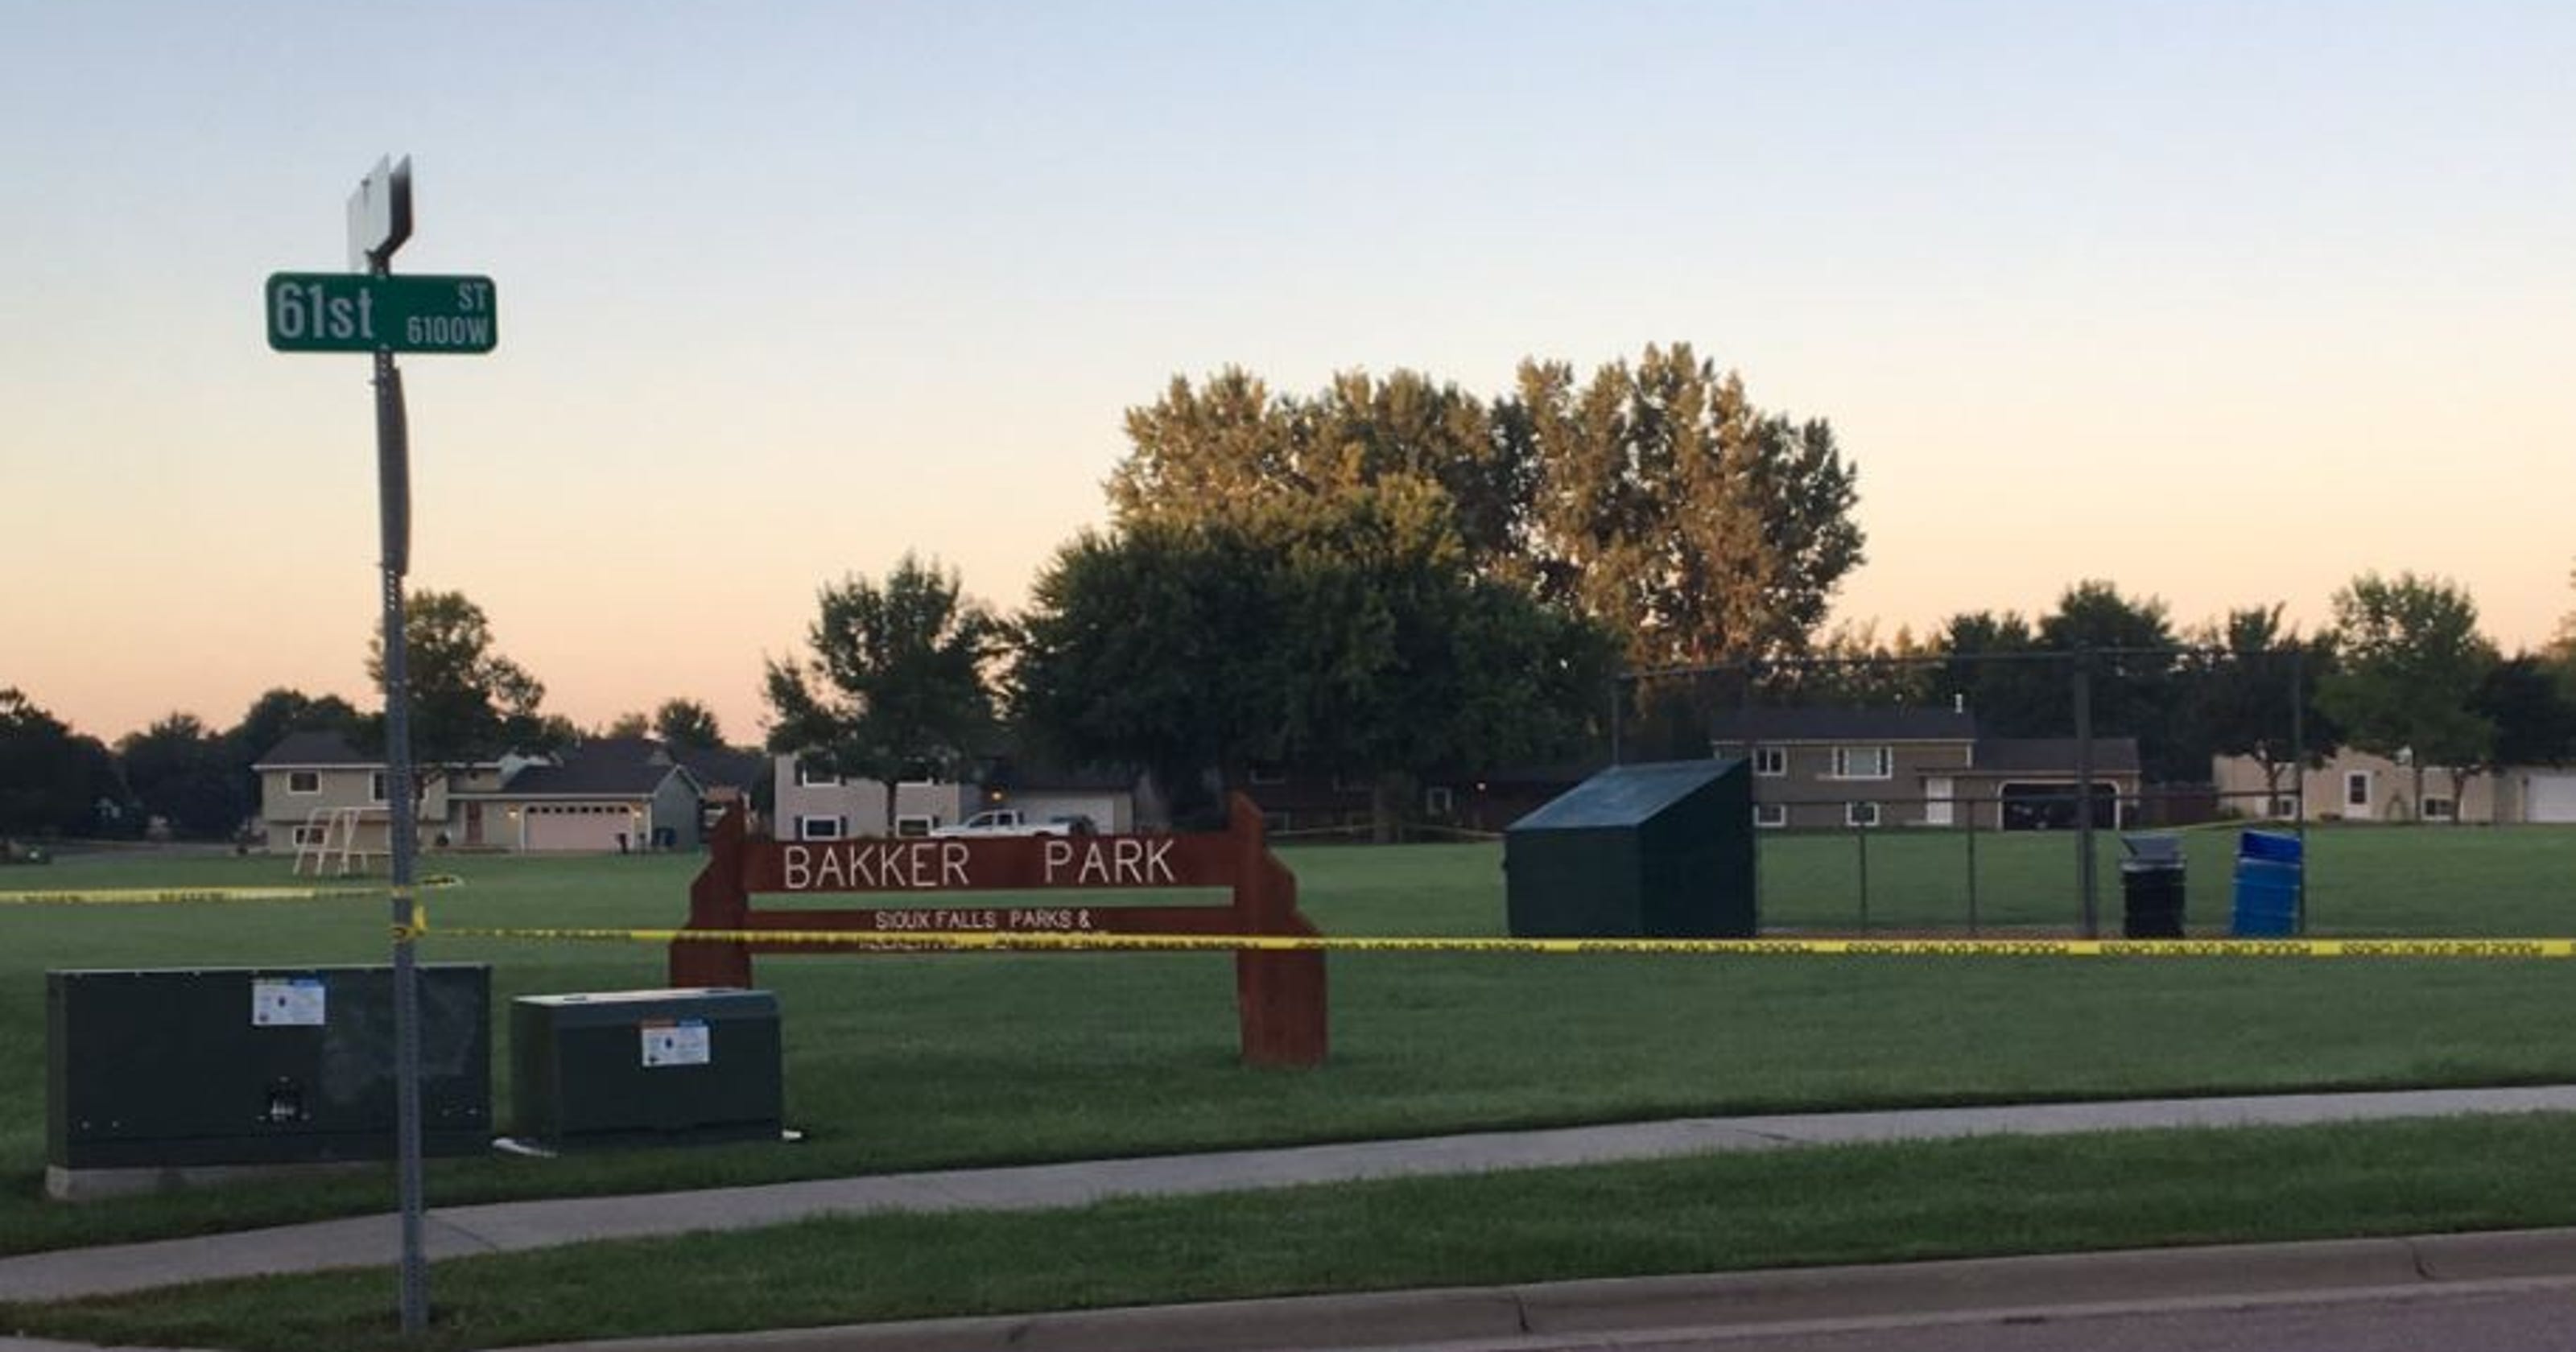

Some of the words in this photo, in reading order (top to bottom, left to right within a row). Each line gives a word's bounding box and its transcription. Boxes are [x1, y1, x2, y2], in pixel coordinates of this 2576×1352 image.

[275, 282, 376, 340] 61st
[457, 282, 488, 311] ST
[407, 316, 489, 344] 6100W
[784, 842, 970, 889] BAKKER
[1045, 839, 1175, 884] PARK
[875, 910, 931, 929] SIOUX
[935, 910, 997, 929] FALLS
[1010, 909, 1072, 929] PARKS
[1078, 909, 1092, 929] &
